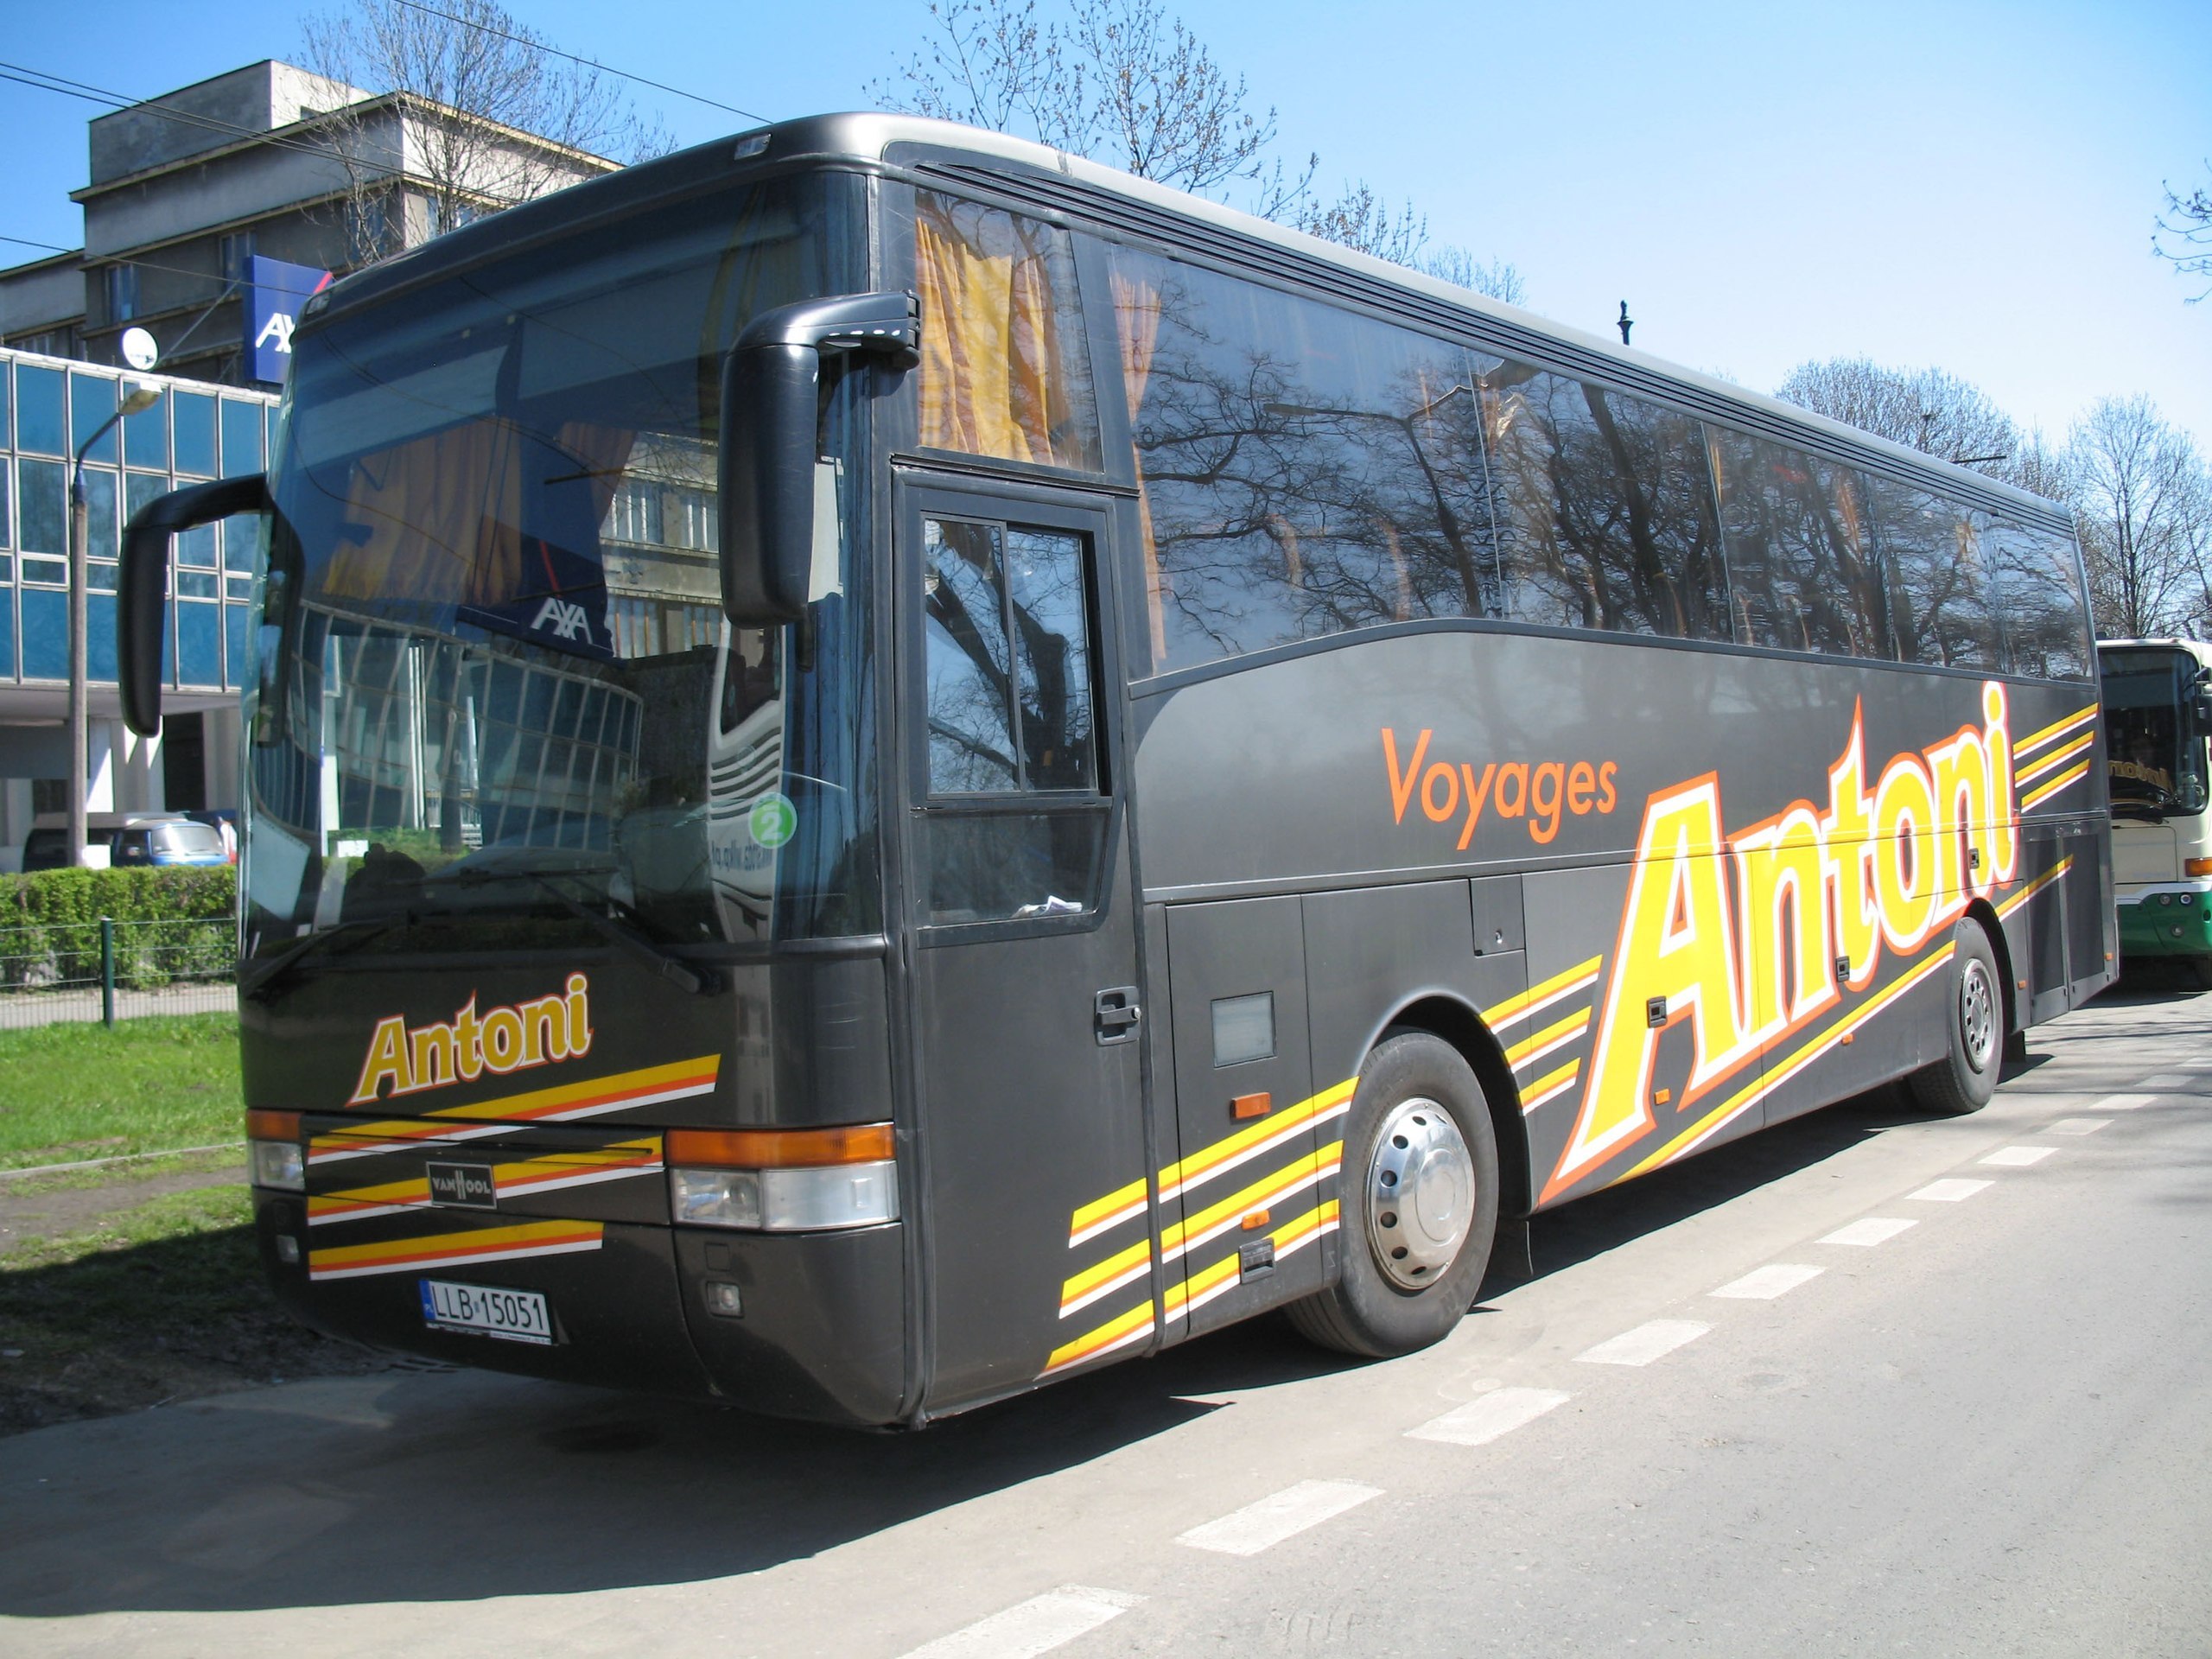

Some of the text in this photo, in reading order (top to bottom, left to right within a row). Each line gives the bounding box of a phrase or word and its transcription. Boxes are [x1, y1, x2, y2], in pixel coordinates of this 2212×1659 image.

[255, 312, 296, 354] AX
[760, 811, 784, 842] 2
[1380, 728, 1618, 850] Voyages
[1538, 679, 2020, 1212] Antoni
[346, 970, 593, 1108] Antoni
[431, 1285, 474, 1321] LLB
[480, 1292, 543, 1332] 15051
